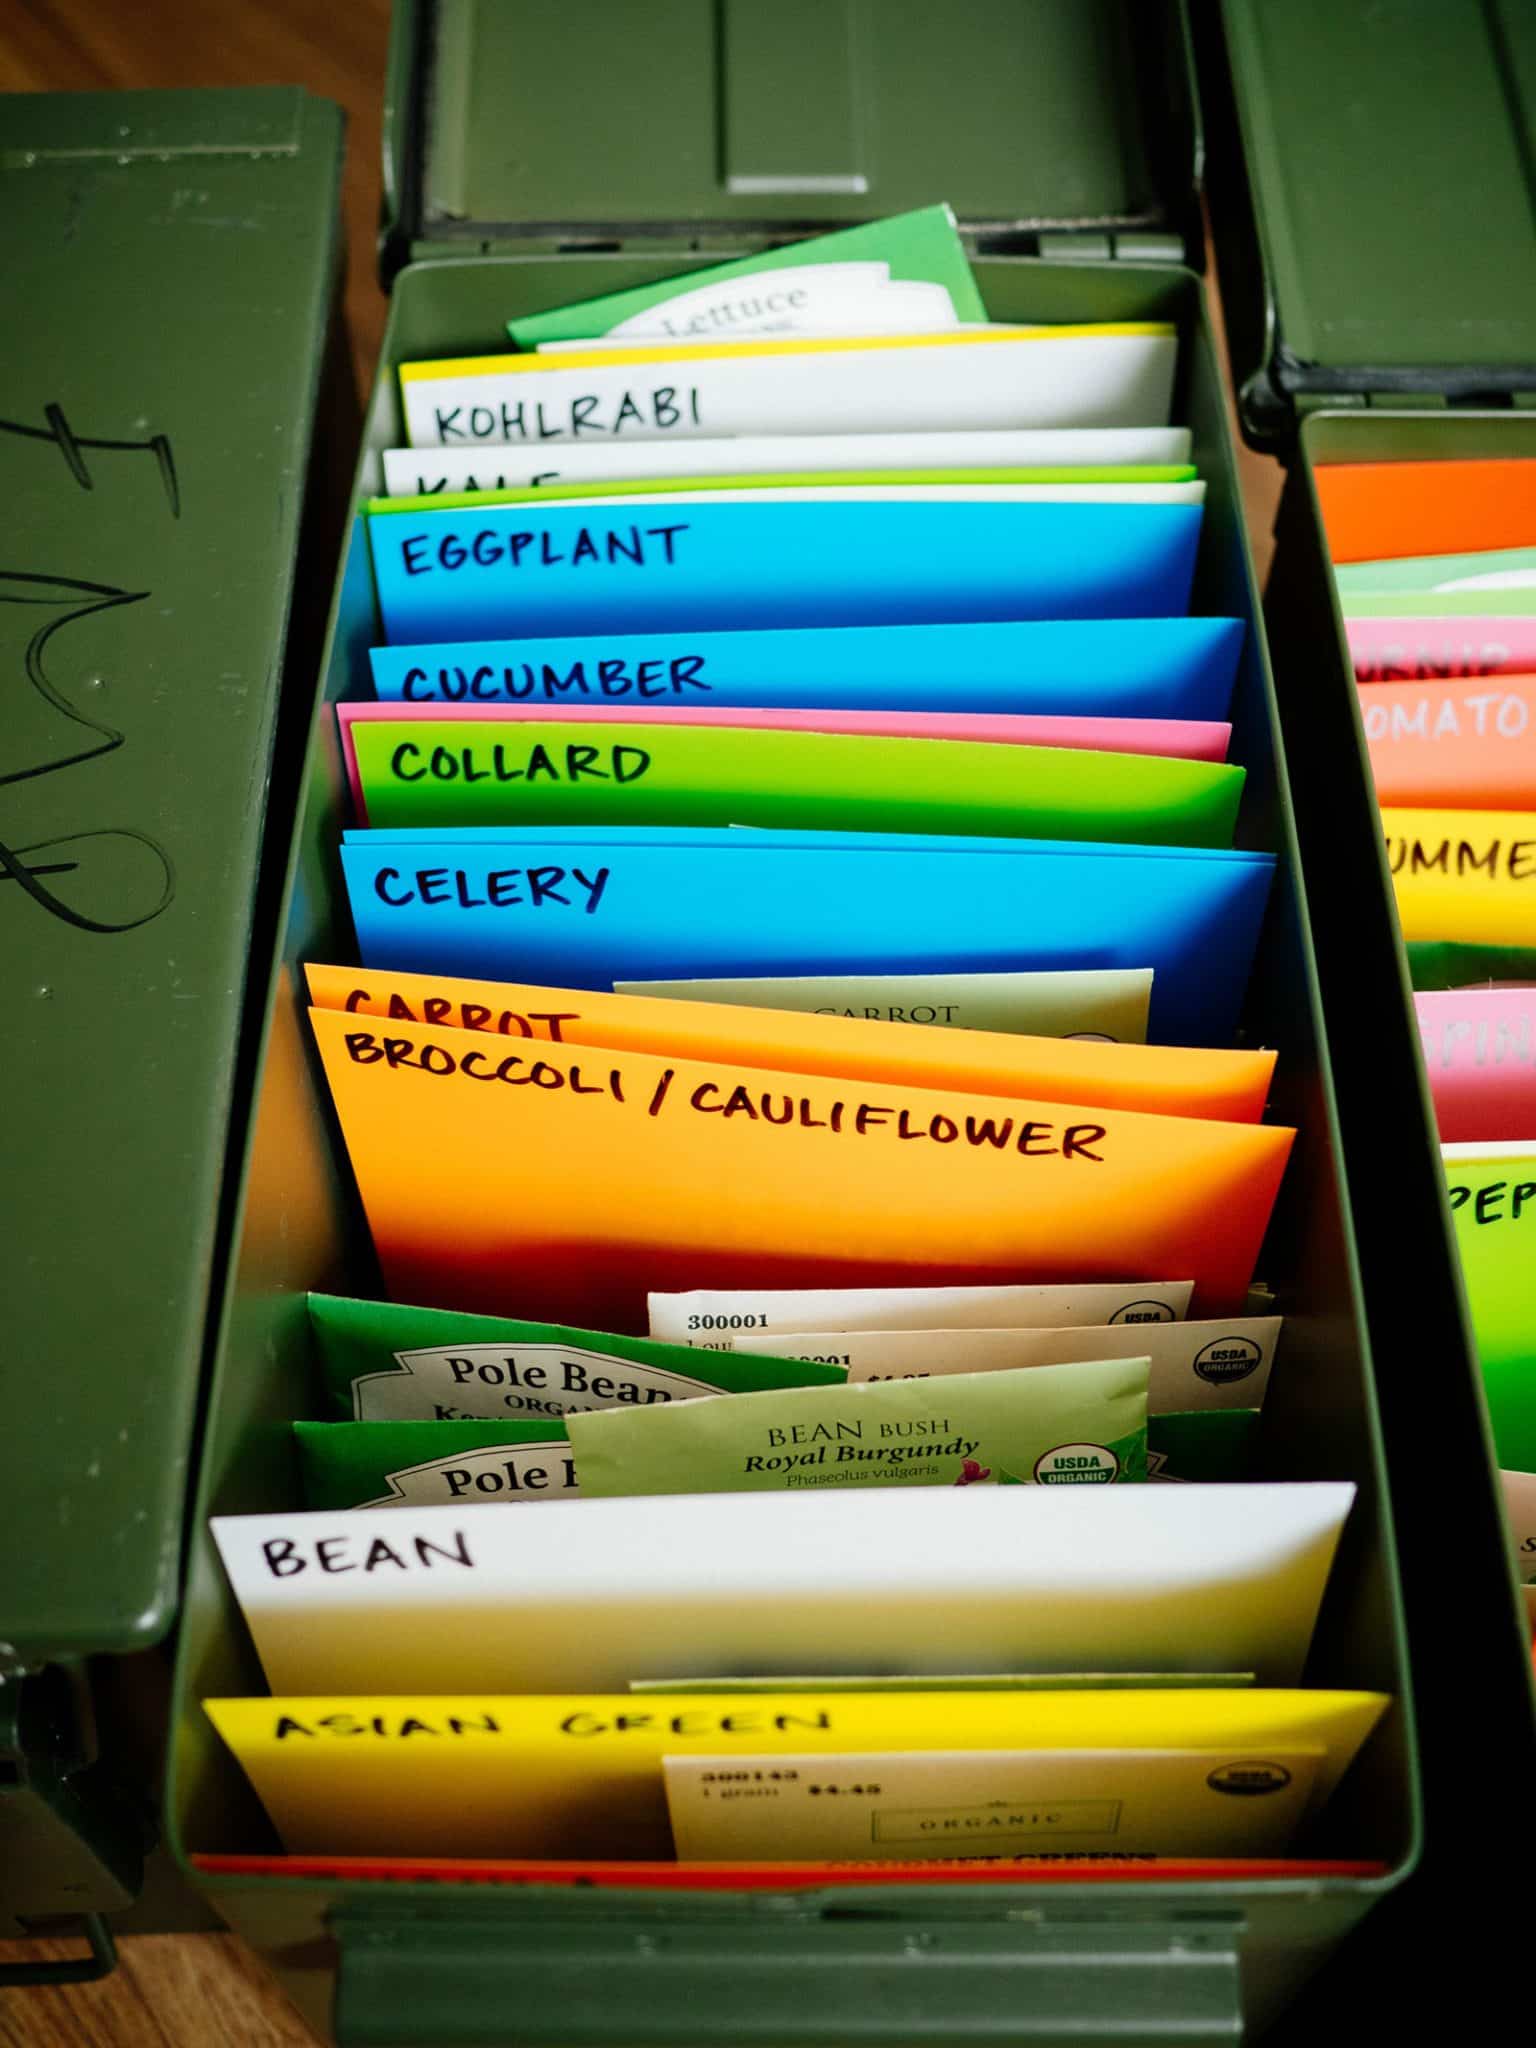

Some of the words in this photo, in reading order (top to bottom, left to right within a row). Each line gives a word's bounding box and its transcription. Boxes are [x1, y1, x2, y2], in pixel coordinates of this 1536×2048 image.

[435, 388, 701, 445] KOHLRABI
[402, 524, 689, 575] EGGPLANT
[402, 656, 712, 701] CUCUMBER
[1353, 640, 1512, 683] URNIP
[1361, 693, 1530, 741] OMATO
[391, 743, 651, 784] COLLARD
[1386, 838, 1536, 879] UMME
[374, 866, 610, 914] CELERY
[344, 1033, 625, 1103] BROCCOLI
[691, 1083, 1106, 1162] CAULIFLOWER
[687, 1313, 769, 1331] 300001
[1125, 1312, 1162, 1324] USDA
[1211, 1348, 1248, 1361] USDA
[445, 1357, 548, 1389] Pole
[560, 1361, 688, 1405] Bean
[768, 1420, 864, 1448] BEAN
[880, 1419, 950, 1439] BUSH
[744, 1446, 827, 1473] Royal
[837, 1437, 980, 1465] Burgundy
[1053, 1455, 1101, 1470] USDA
[441, 1461, 550, 1497] Pole
[786, 1469, 868, 1487] Phaseolus
[872, 1463, 940, 1480] vulgaris
[1047, 1471, 1107, 1484] ORGANIC
[262, 1530, 475, 1578] BEAN
[274, 1713, 502, 1739] ASIAN
[560, 1709, 832, 1736] GREEN
[919, 1812, 1062, 1831] ORGANIC
